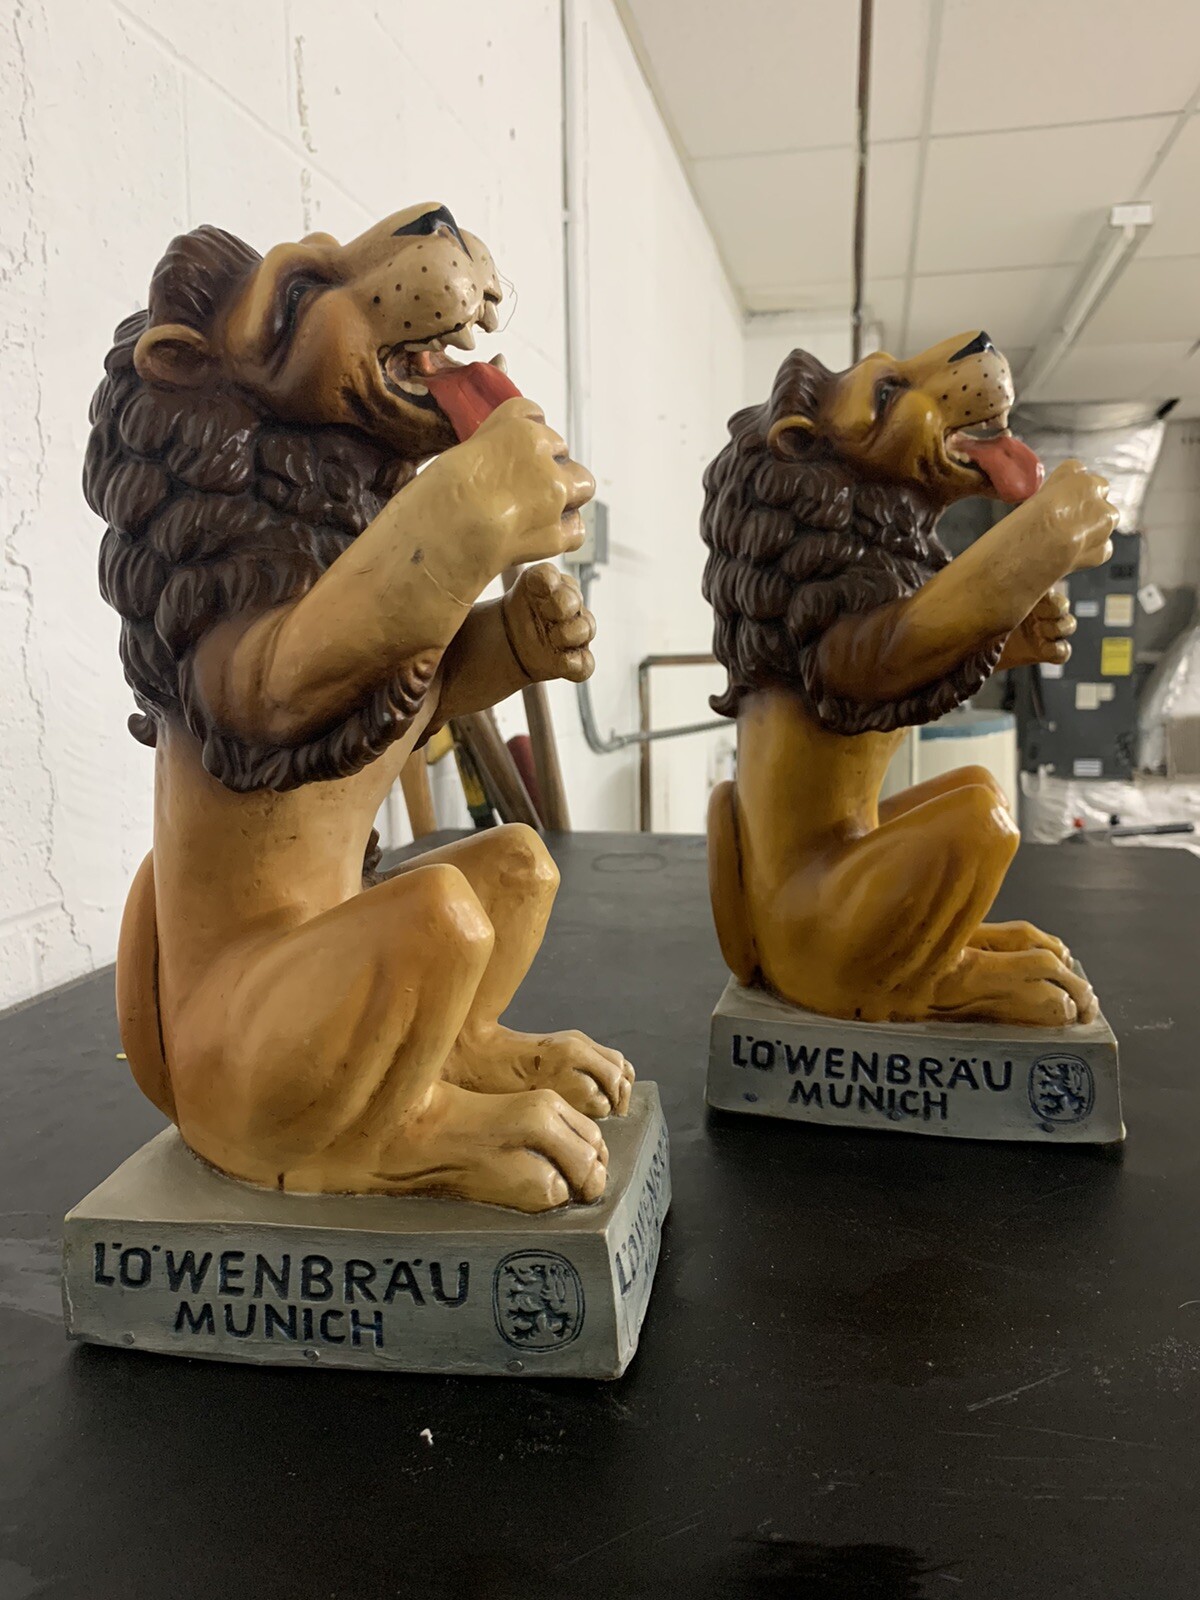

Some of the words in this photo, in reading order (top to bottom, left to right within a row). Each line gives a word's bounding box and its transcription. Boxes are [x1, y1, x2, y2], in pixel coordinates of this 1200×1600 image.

[732, 1034, 1013, 1092] LÖWENBRÄU
[789, 1081, 949, 1121] MUNICH
[94, 1242, 470, 1308] LÖWENBRÄU
[174, 1301, 384, 1349] MUNICH
